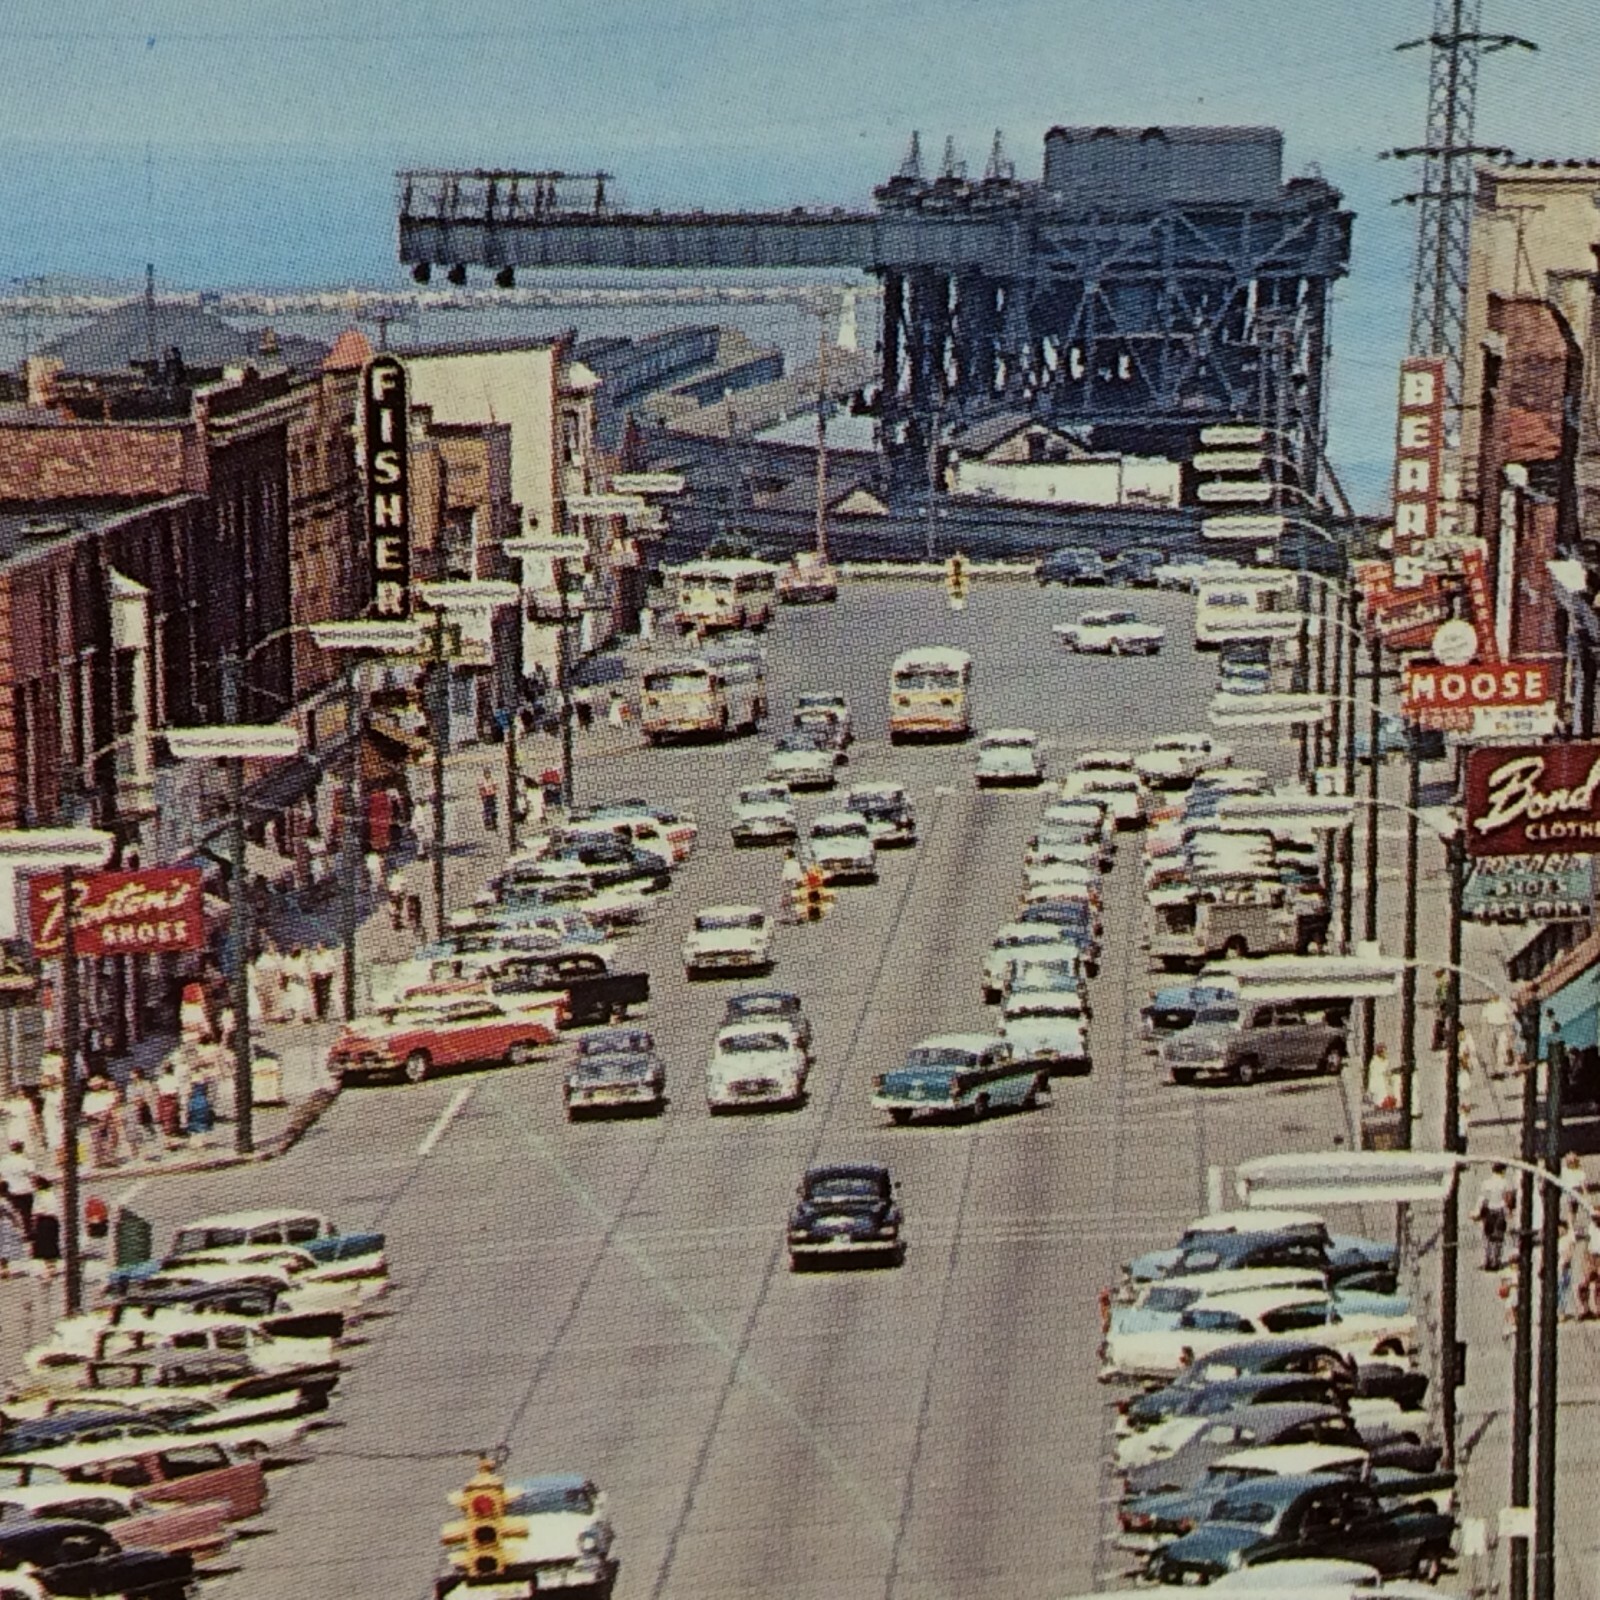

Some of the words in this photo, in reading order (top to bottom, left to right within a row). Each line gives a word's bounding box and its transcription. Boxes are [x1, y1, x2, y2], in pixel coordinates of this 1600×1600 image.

[373, 367, 404, 615] FISHER
[1411, 671, 1542, 701] MOOSE
[1473, 756, 1600, 835] Bond
[102, 920, 187, 945] SHOES
